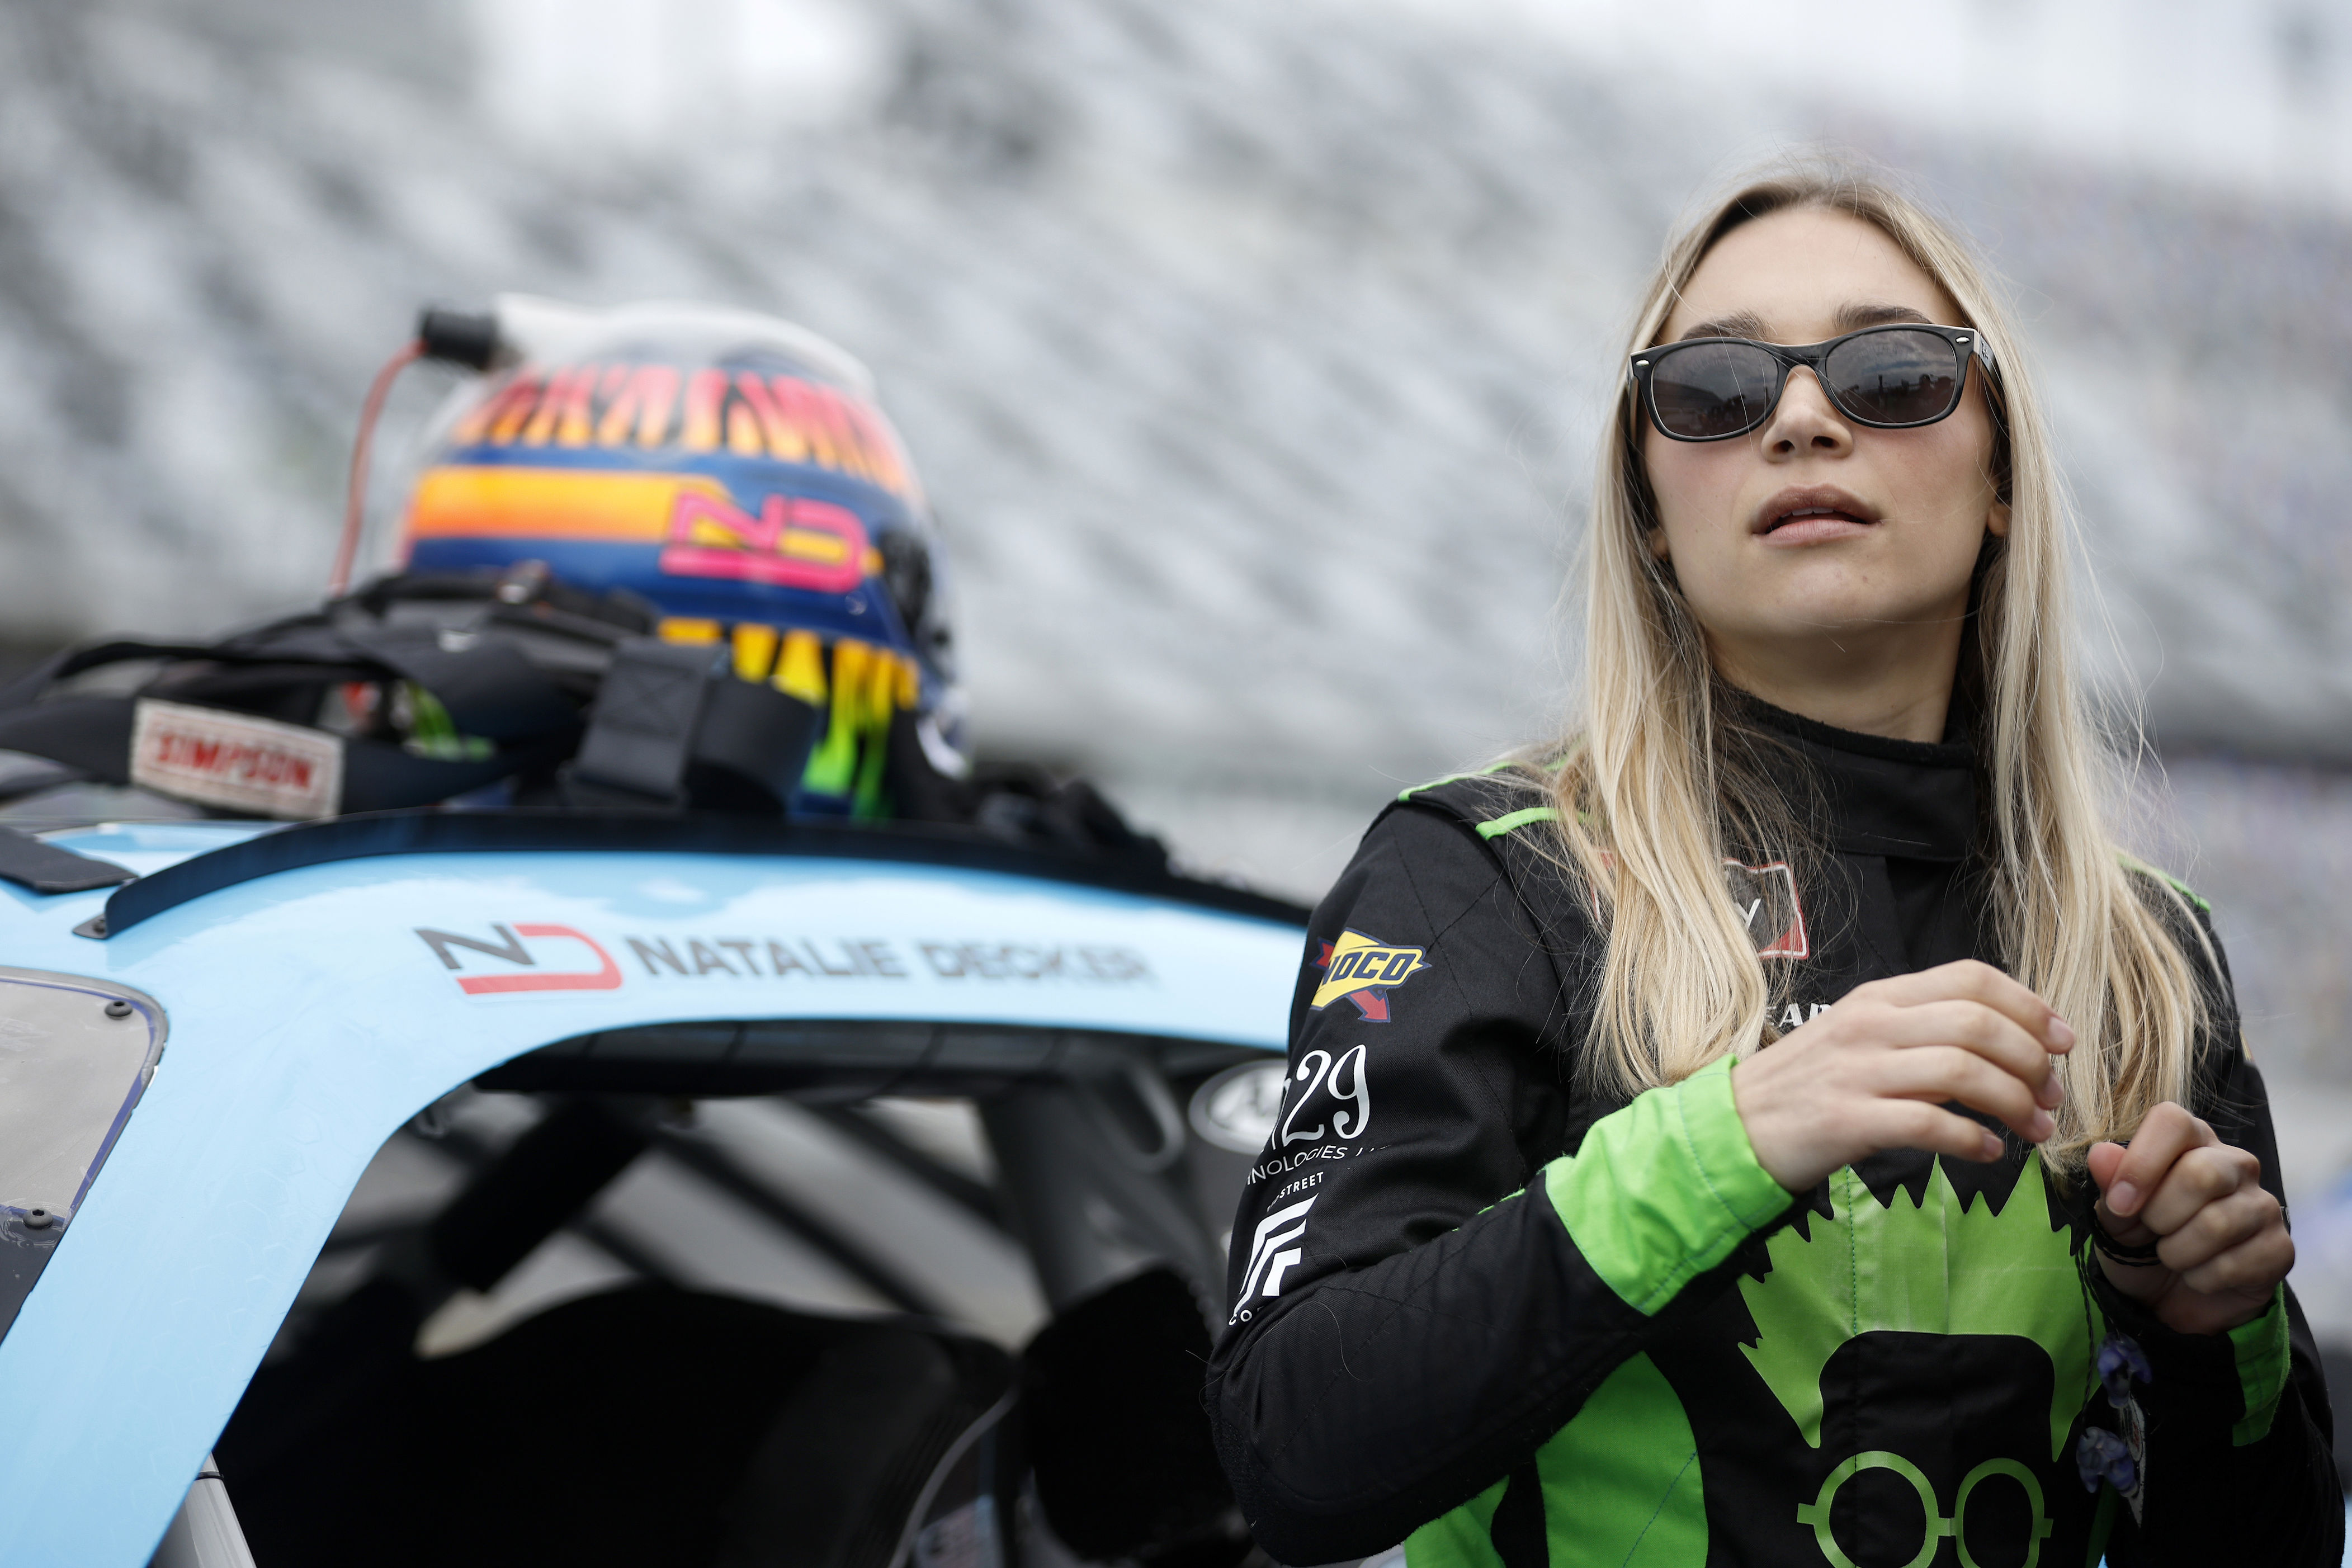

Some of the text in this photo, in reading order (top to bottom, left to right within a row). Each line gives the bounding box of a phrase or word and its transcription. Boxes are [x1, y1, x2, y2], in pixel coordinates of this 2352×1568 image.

[156, 731, 315, 789] SIMPSON
[623, 936, 909, 979] NATALIE
[914, 938, 1161, 983] DECKER
[1270, 1043, 1370, 1150] 29
[1247, 1145, 1348, 1185] NOLOGIES
